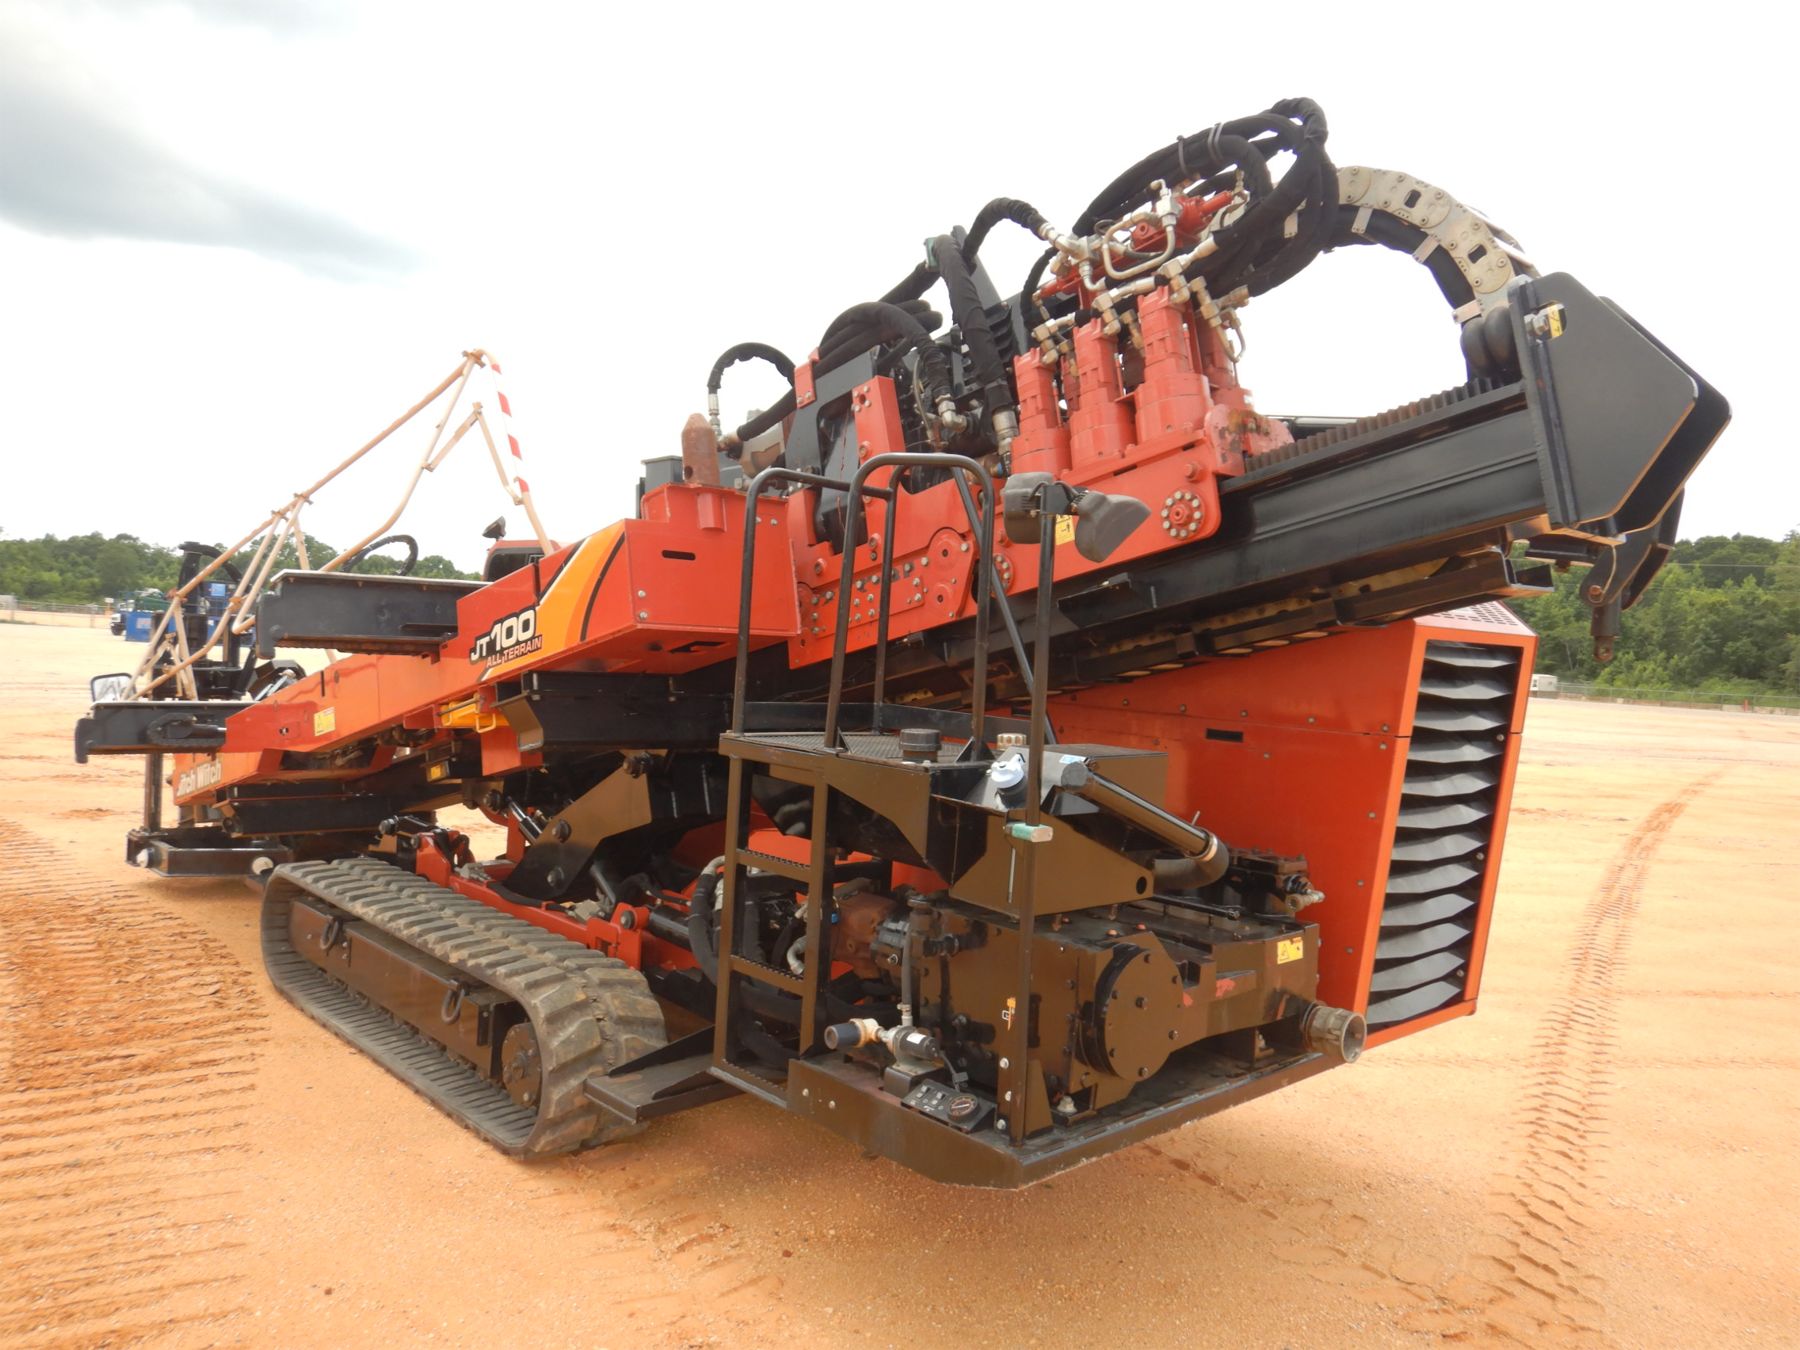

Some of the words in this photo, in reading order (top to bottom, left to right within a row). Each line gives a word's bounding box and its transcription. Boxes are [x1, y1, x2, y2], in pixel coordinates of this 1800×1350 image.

[471, 609, 535, 661] JT100
[486, 653, 502, 667] ALL
[503, 636, 542, 661] TERRAIN
